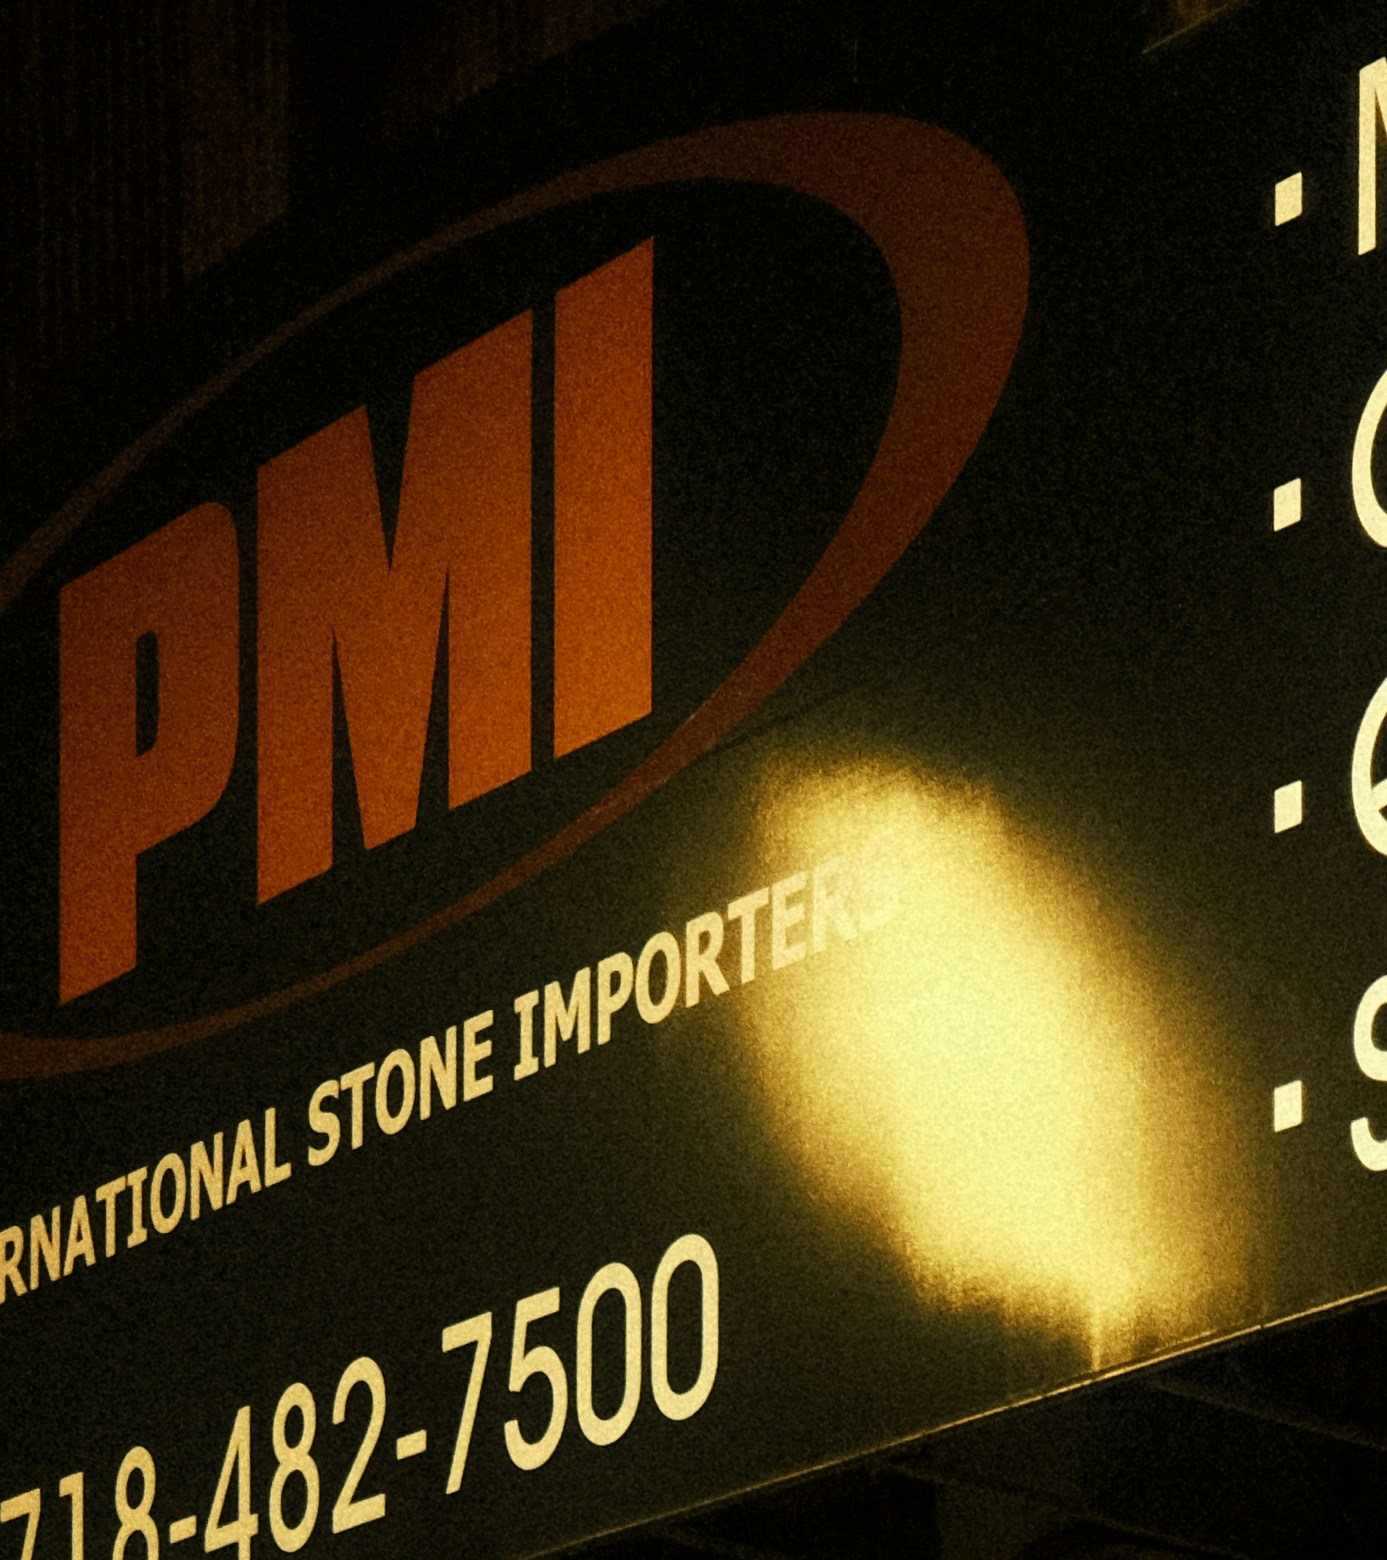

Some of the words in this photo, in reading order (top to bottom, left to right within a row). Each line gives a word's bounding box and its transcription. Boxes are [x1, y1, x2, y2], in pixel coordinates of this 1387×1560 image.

[58, 235, 655, 1005] PMI
[0, 1107, 292, 1299] RNATIONAL
[307, 1009, 494, 1167] STONE
